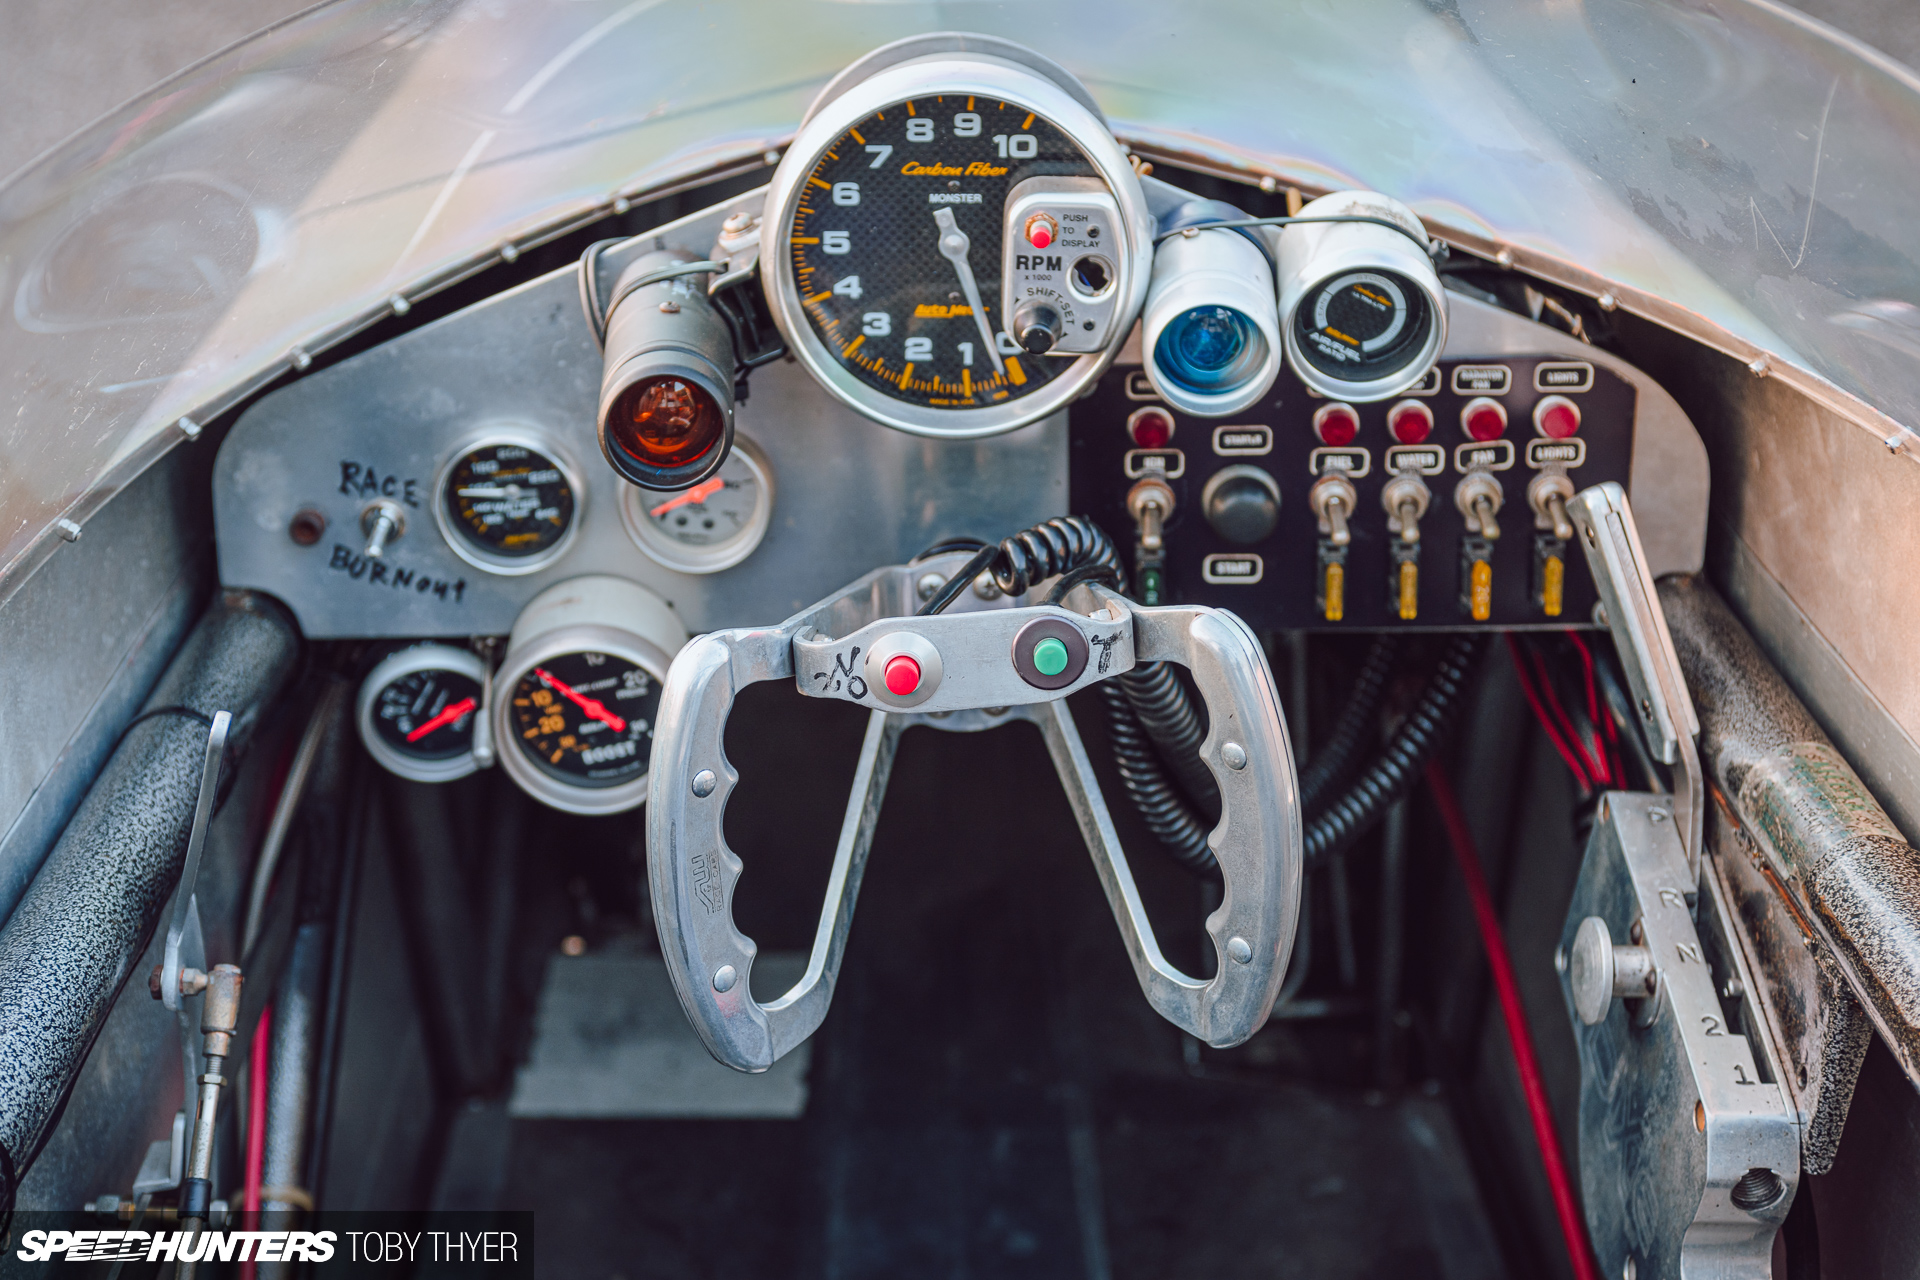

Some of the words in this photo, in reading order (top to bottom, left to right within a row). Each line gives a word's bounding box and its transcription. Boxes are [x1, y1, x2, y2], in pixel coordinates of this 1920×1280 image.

[906, 118, 934, 142] 8
[954, 112, 982, 137] 9
[865, 145, 893, 169] 7
[993, 134, 1038, 159] 10
[901, 161, 963, 176] Carbon
[964, 161, 1008, 176] Fiber
[832, 182, 861, 206] 6
[928, 193, 982, 204] MONSTER
[1062, 214, 1088, 222] PUSH
[822, 231, 851, 254] 5
[1061, 239, 1100, 248] DISPLAY
[1016, 255, 1062, 271] RPM
[833, 275, 862, 299] 4
[1026, 287, 1075, 326] SHIFT-SET
[862, 312, 891, 336] 3
[904, 337, 933, 361] 2
[957, 342, 974, 366] 1
[1309, 332, 1361, 363] AIR/FUEL
[1317, 343, 1346, 362] RATIO
[1547, 372, 1579, 384] LIGHTS
[1395, 453, 1436, 467] WATER
[1471, 450, 1496, 464] FAN
[1535, 446, 1576, 461] LIGHTS
[338, 459, 418, 508] RACE
[622, 669, 648, 689] 20
[530, 689, 553, 707] 10
[538, 714, 565, 735] 20
[581, 740, 637, 766] BOOST
[1659, 886, 1683, 909] R
[1676, 942, 1702, 964] N
[1701, 1013, 1725, 1036] 2
[1734, 1063, 1756, 1085] 1
